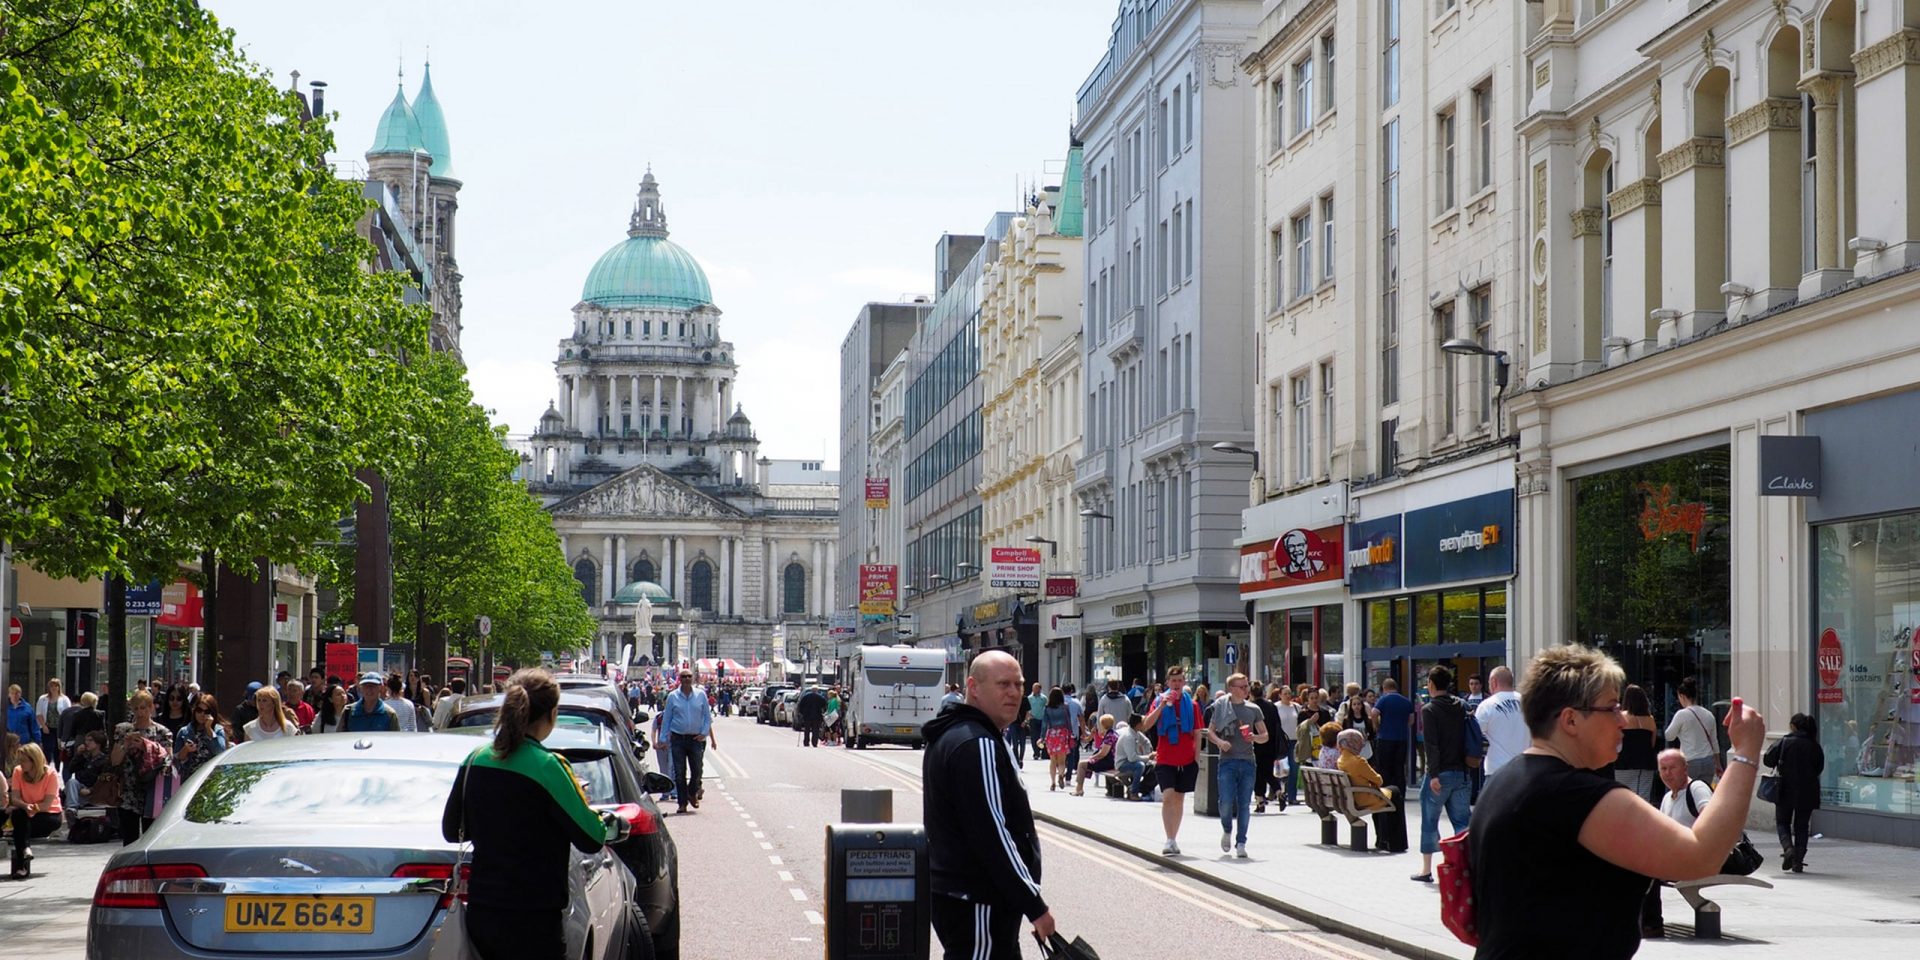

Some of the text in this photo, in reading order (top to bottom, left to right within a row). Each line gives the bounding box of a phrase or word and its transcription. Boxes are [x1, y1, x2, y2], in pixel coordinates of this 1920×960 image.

[1768, 476, 1814, 490] Clarks
[1636, 481, 1706, 554] Disney
[1440, 530, 1482, 553] everything
[1240, 551, 1267, 584] KFC
[1048, 586, 1074, 594] oasis
[1820, 655, 1842, 671] SALE
[1849, 674, 1882, 682] upstairs
[850, 851, 911, 859] PEDESTRIANS
[850, 881, 912, 899] WAIT
[236, 902, 363, 926] UNZ 6643
